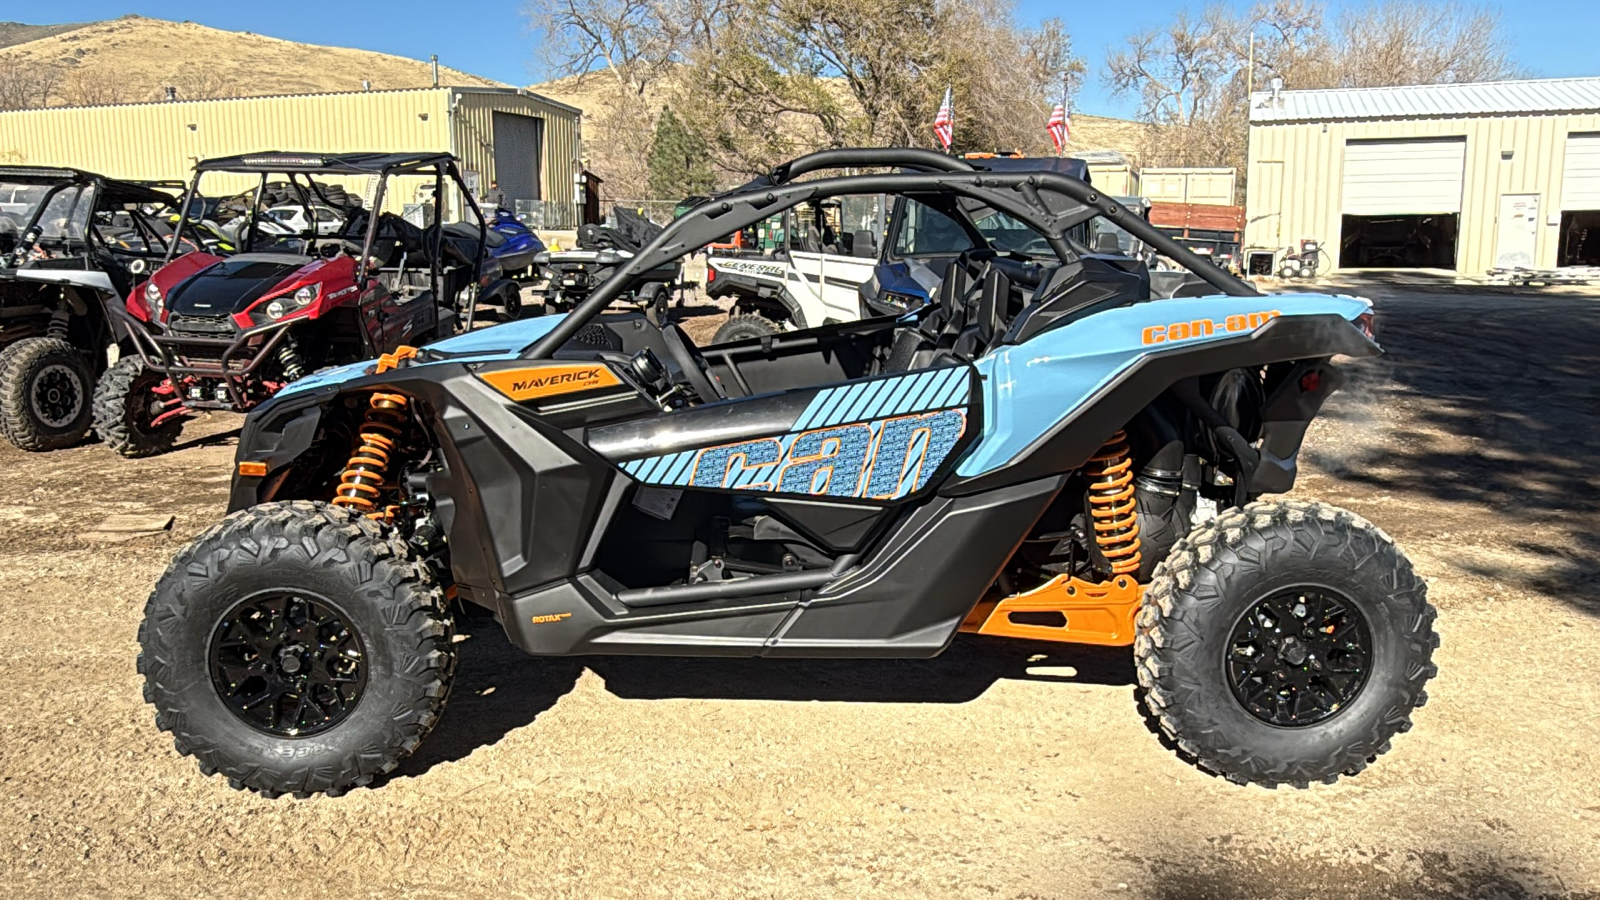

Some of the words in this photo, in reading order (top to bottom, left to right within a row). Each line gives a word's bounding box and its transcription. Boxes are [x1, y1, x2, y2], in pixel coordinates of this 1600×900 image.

[723, 261, 782, 274] GENERAL
[1141, 309, 1282, 346] can-am
[512, 368, 601, 392] MAVERICK
[532, 613, 561, 624] ROTAX
